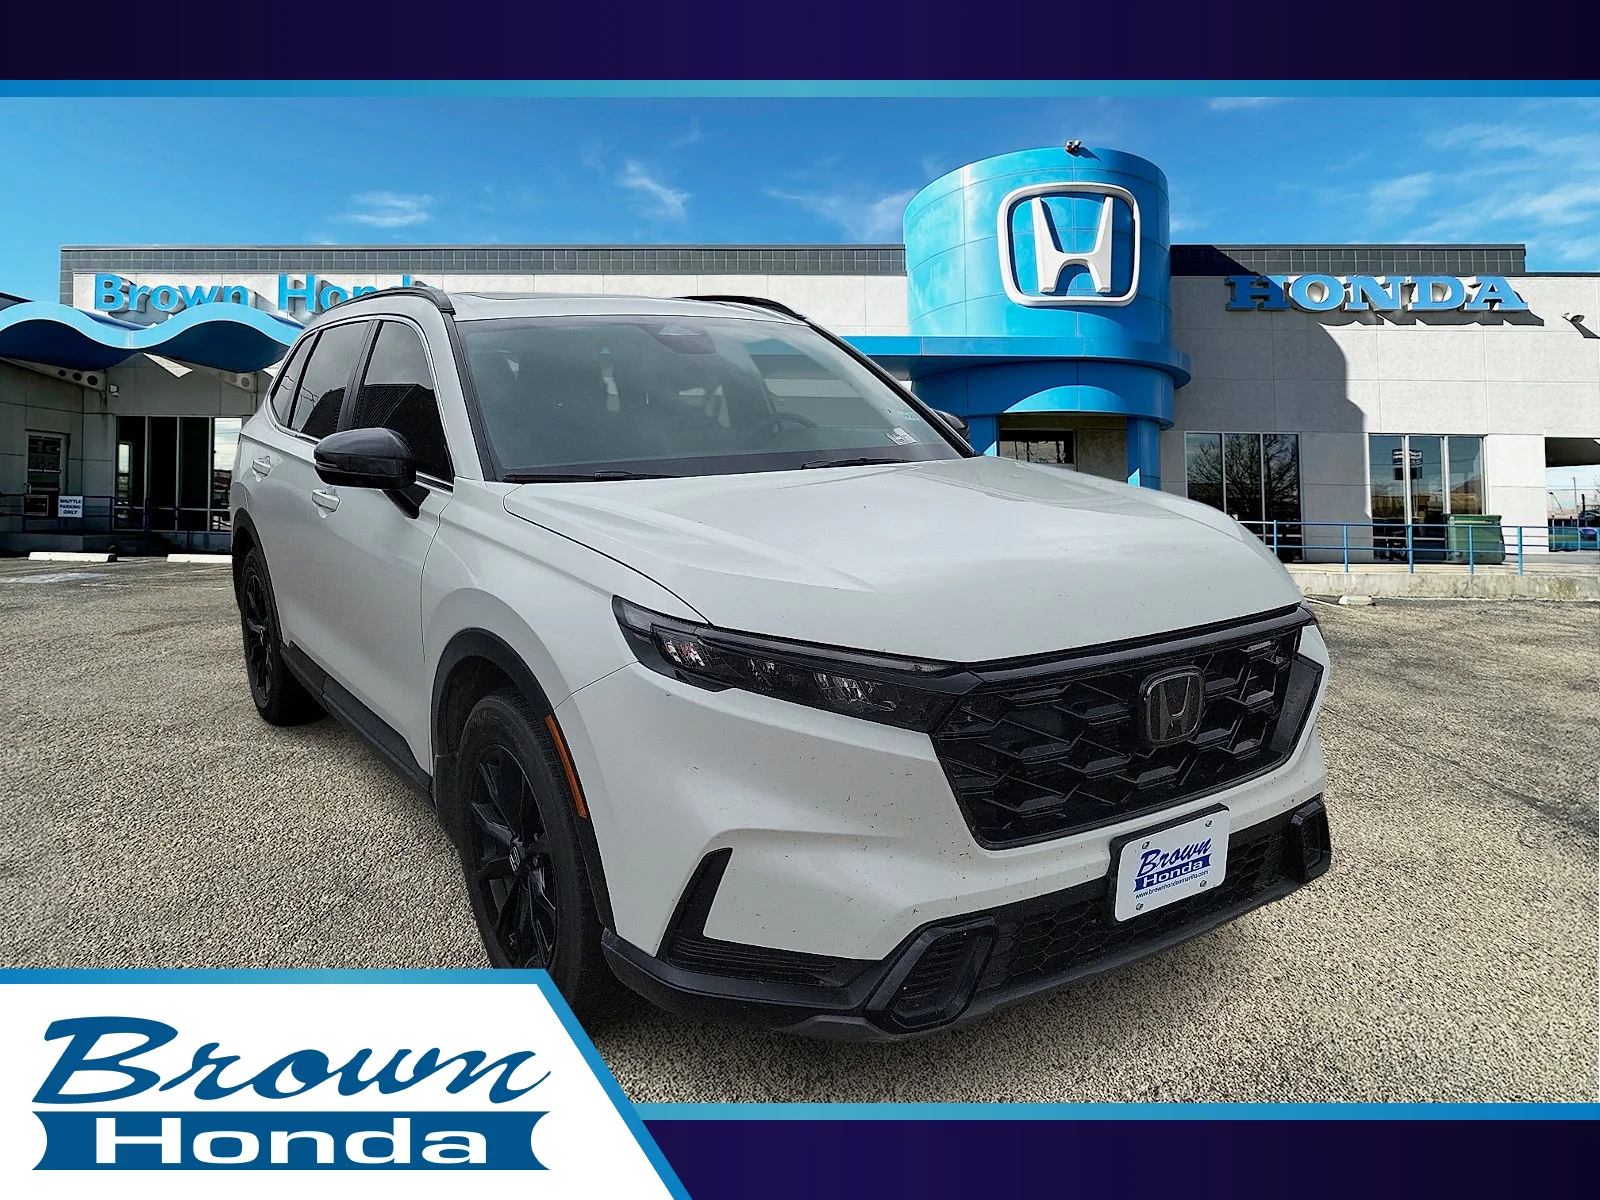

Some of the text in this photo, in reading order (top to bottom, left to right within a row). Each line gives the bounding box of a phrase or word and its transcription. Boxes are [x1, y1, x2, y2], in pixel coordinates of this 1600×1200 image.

[95, 273, 250, 312] Brown
[1228, 274, 1529, 311] HONDA
[1136, 837, 1212, 878] Brown
[1142, 860, 1204, 887] Honda
